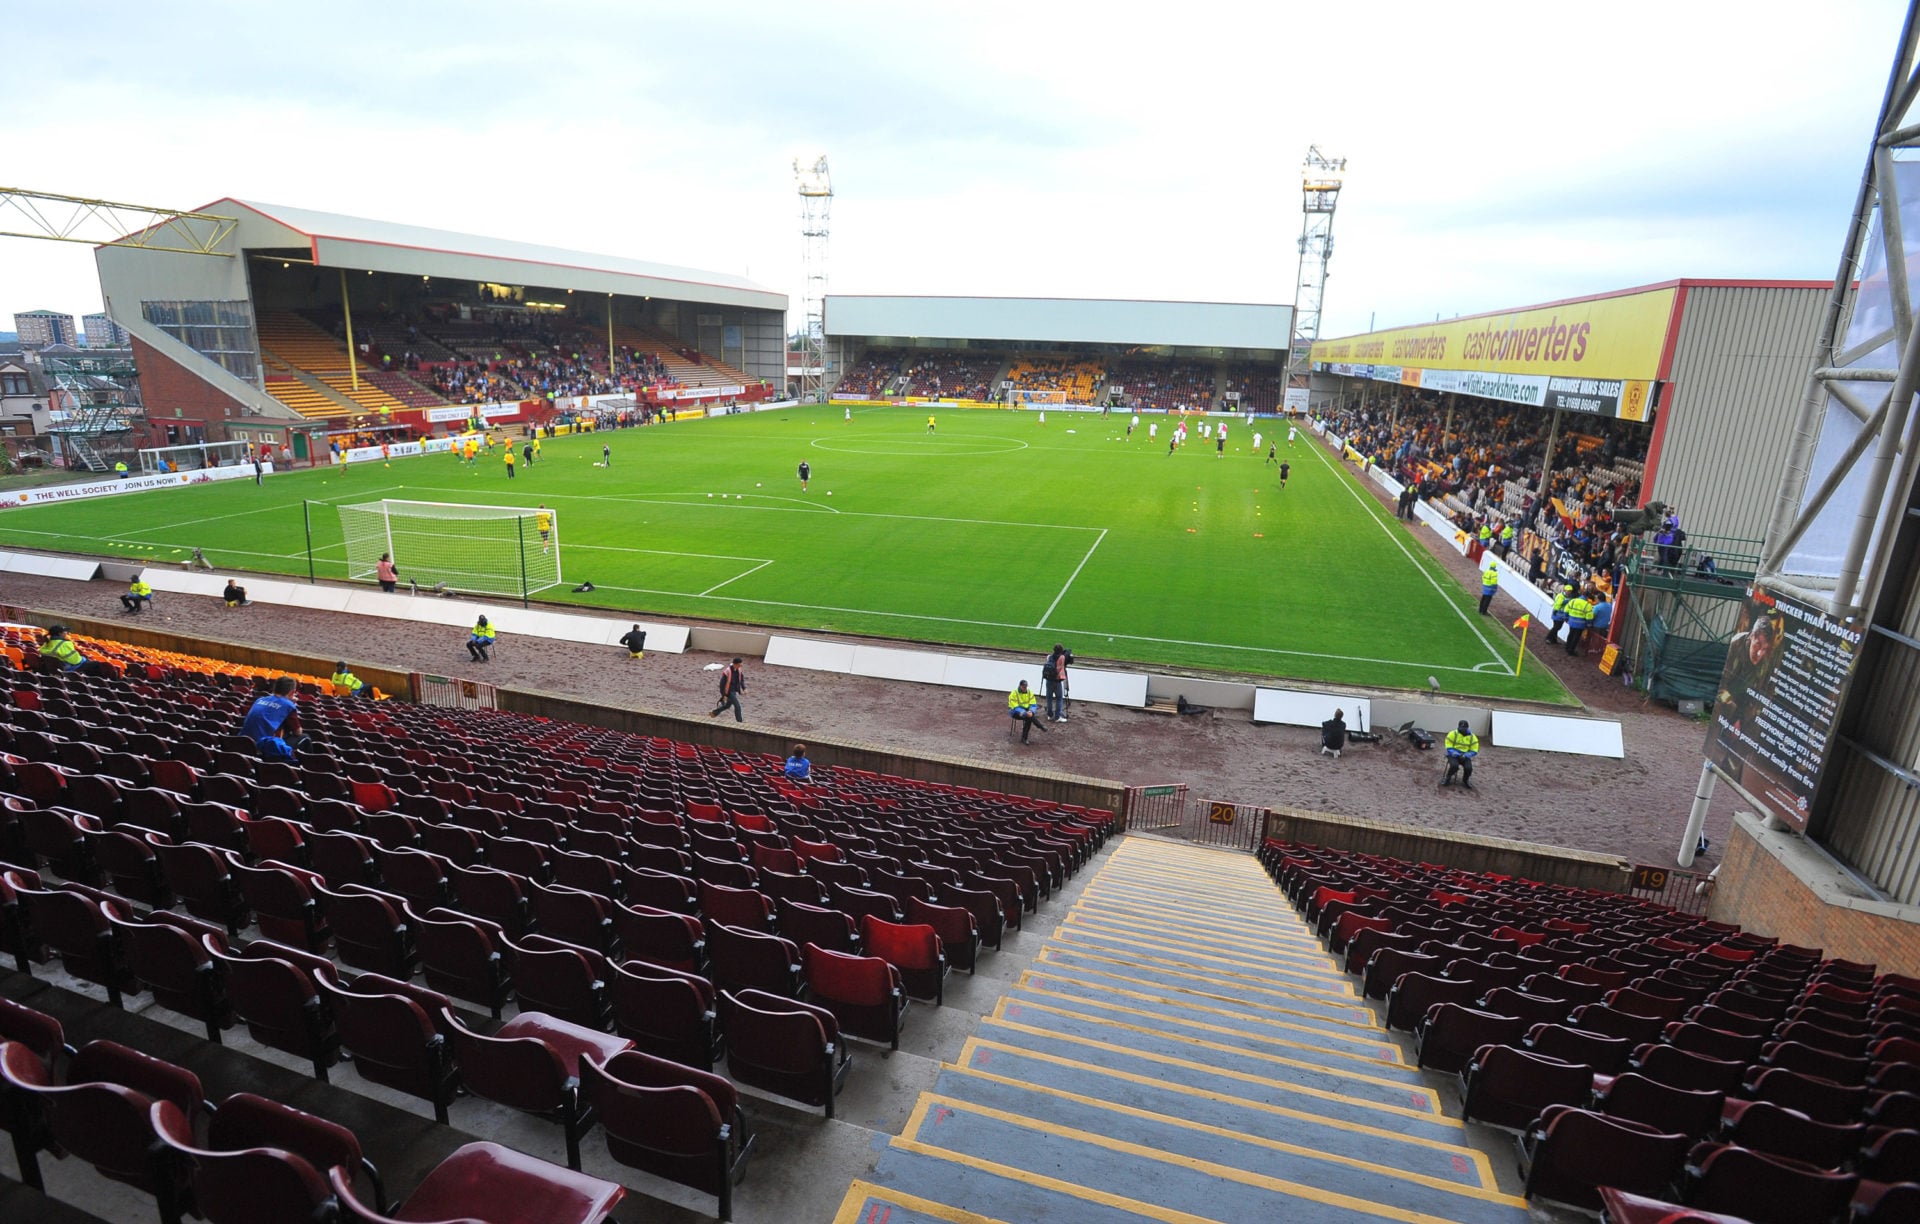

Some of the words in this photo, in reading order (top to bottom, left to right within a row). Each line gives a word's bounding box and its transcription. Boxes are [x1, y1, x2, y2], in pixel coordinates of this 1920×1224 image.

[1463, 315, 1591, 362] cashconverters
[1466, 374, 1539, 403] VisitLanarkshire.com
[1580, 379, 1599, 396] VANS
[1598, 381, 1620, 398] SALES
[35, 491, 54, 501] THE
[56, 487, 81, 499] WELL
[82, 484, 118, 495] SOCIETY
[124, 481, 142, 490] JOIN
[156, 477, 177, 486] NOW!
[1746, 587, 1753, 597] IS
[1775, 599, 1802, 620] THICKER
[1803, 612, 1825, 629] THAN
[1825, 620, 1861, 644] VODKA?
[1746, 687, 1756, 698] FOR
[1759, 694, 1771, 707] FREE
[1792, 716, 1809, 732] SMOKE
[1808, 728, 1827, 743] ALARM
[1754, 715, 1785, 741] FREEPHONE
[1762, 707, 1778, 721] FITTED
[1777, 717, 1789, 729] FREE
[1788, 724, 1795, 733] IN
[1794, 727, 1809, 742] THEIR
[1808, 737, 1825, 753] HOME
[1718, 714, 1729, 729] Help
[1739, 733, 1759, 750] protect
[1757, 745, 1771, 758] your
[1770, 753, 1788, 772] family
[1787, 765, 1803, 781] from
[1802, 775, 1815, 789] fire
[1106, 794, 1119, 808] 13
[1210, 805, 1235, 822] 20
[1271, 819, 1286, 834] 12
[1640, 870, 1665, 888] 19
